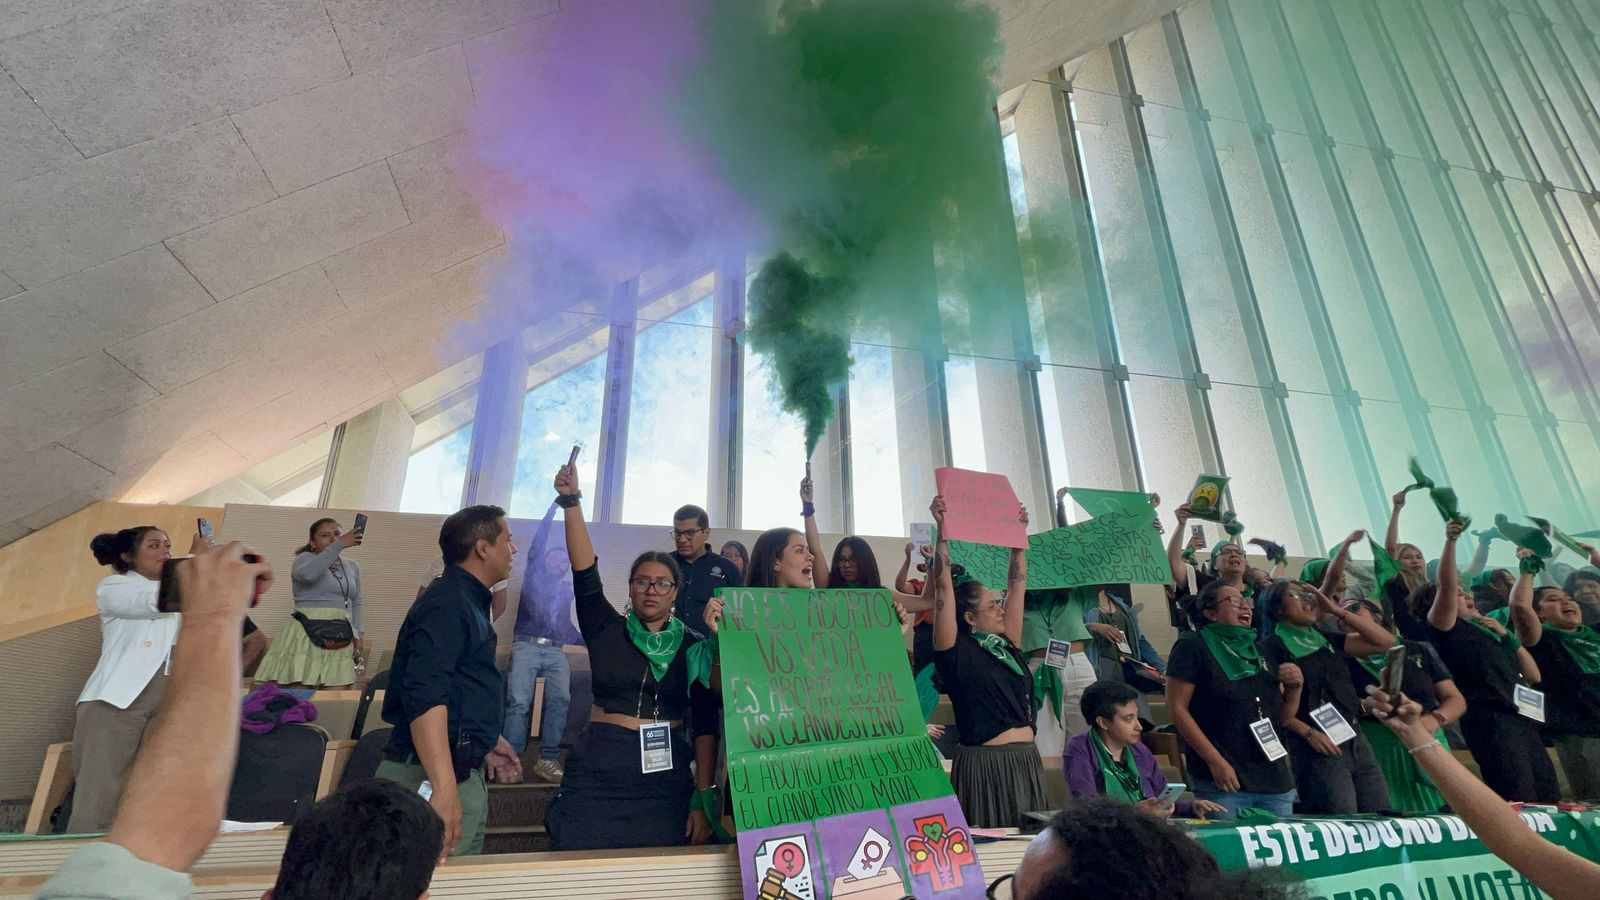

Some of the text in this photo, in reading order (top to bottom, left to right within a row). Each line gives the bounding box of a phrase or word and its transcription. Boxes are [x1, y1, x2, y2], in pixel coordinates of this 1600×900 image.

[1031, 534, 1088, 557] SOBRE
[1095, 524, 1125, 540] SUS
[1048, 529, 1072, 541] ES
[1077, 508, 1139, 534] ILEGAL
[1042, 550, 1073, 565] LAS
[1081, 529, 1152, 555] MUERTAS
[1051, 562, 1076, 576] LA
[1078, 546, 1157, 569] INDUSTRIA
[1063, 564, 1166, 586] CLANDESTINO
[720, 590, 893, 631] NO ES ABORTO
[794, 630, 867, 673] VIDA
[731, 672, 905, 714] ES ABORTO LEGAL
[777, 705, 905, 746] CLANDESTINO
[731, 757, 755, 794] EL
[760, 750, 822, 793] ABORTO
[823, 747, 872, 784] LEGAL
[868, 744, 889, 777] ES
[739, 774, 920, 830] EL CLANDESTINO MATA
[1236, 822, 1320, 868] ESTE
[1313, 820, 1402, 857] DEDO
[1394, 817, 1443, 845] NO
